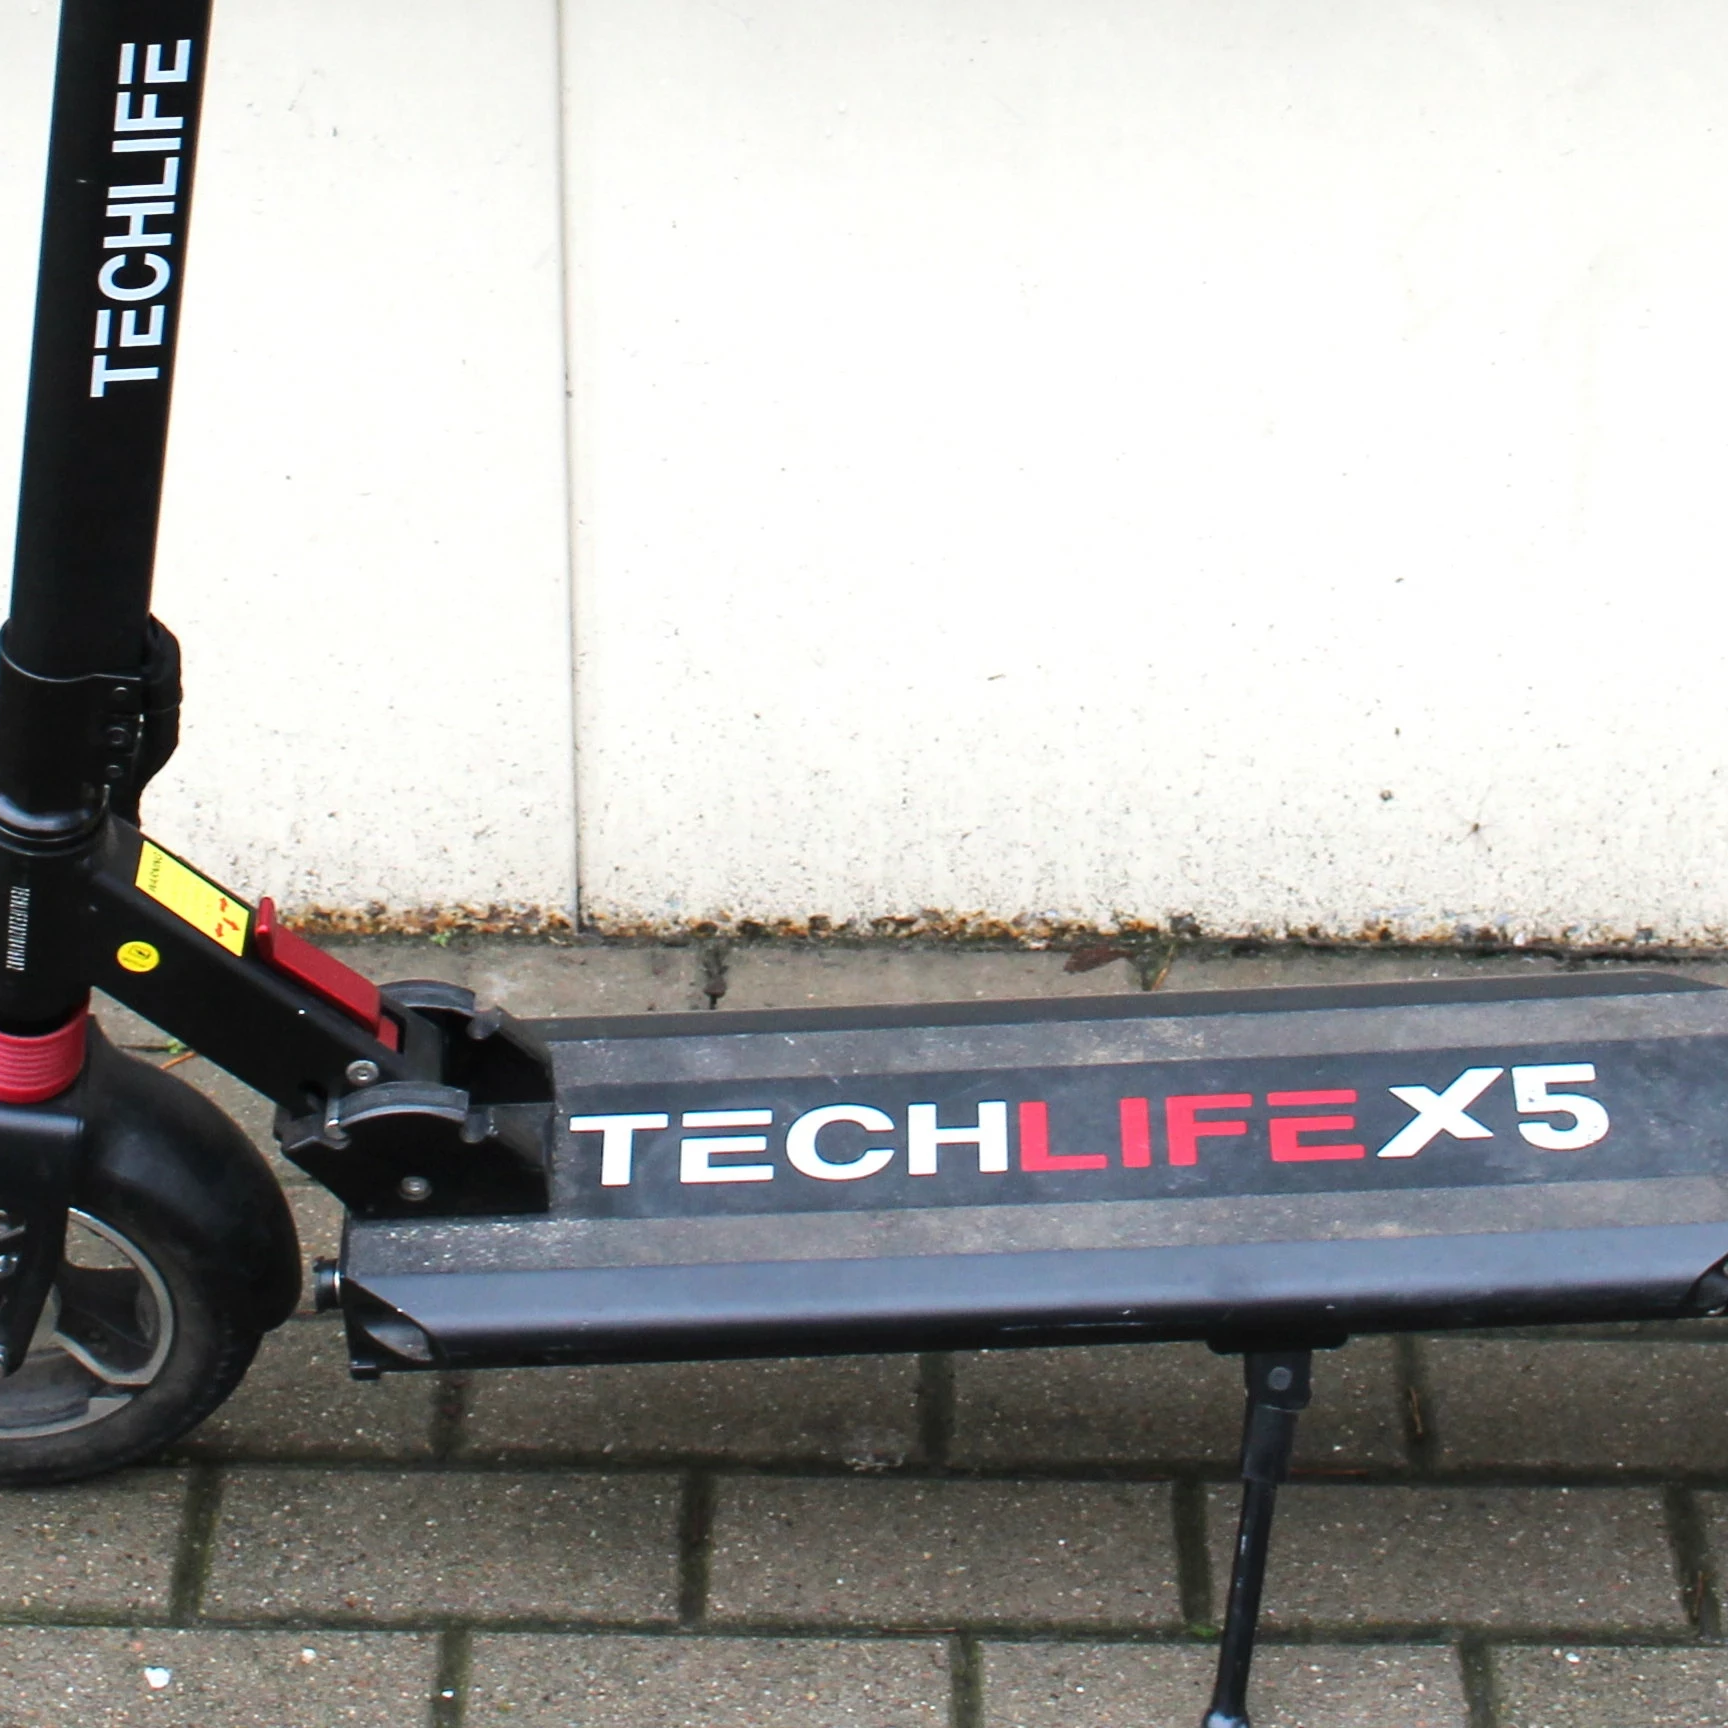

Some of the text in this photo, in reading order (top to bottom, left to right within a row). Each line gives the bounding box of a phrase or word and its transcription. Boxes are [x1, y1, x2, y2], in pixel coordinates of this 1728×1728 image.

[88, 37, 193, 400] TECHLIFE
[568, 1062, 1611, 1188] TECHLIFE X5
